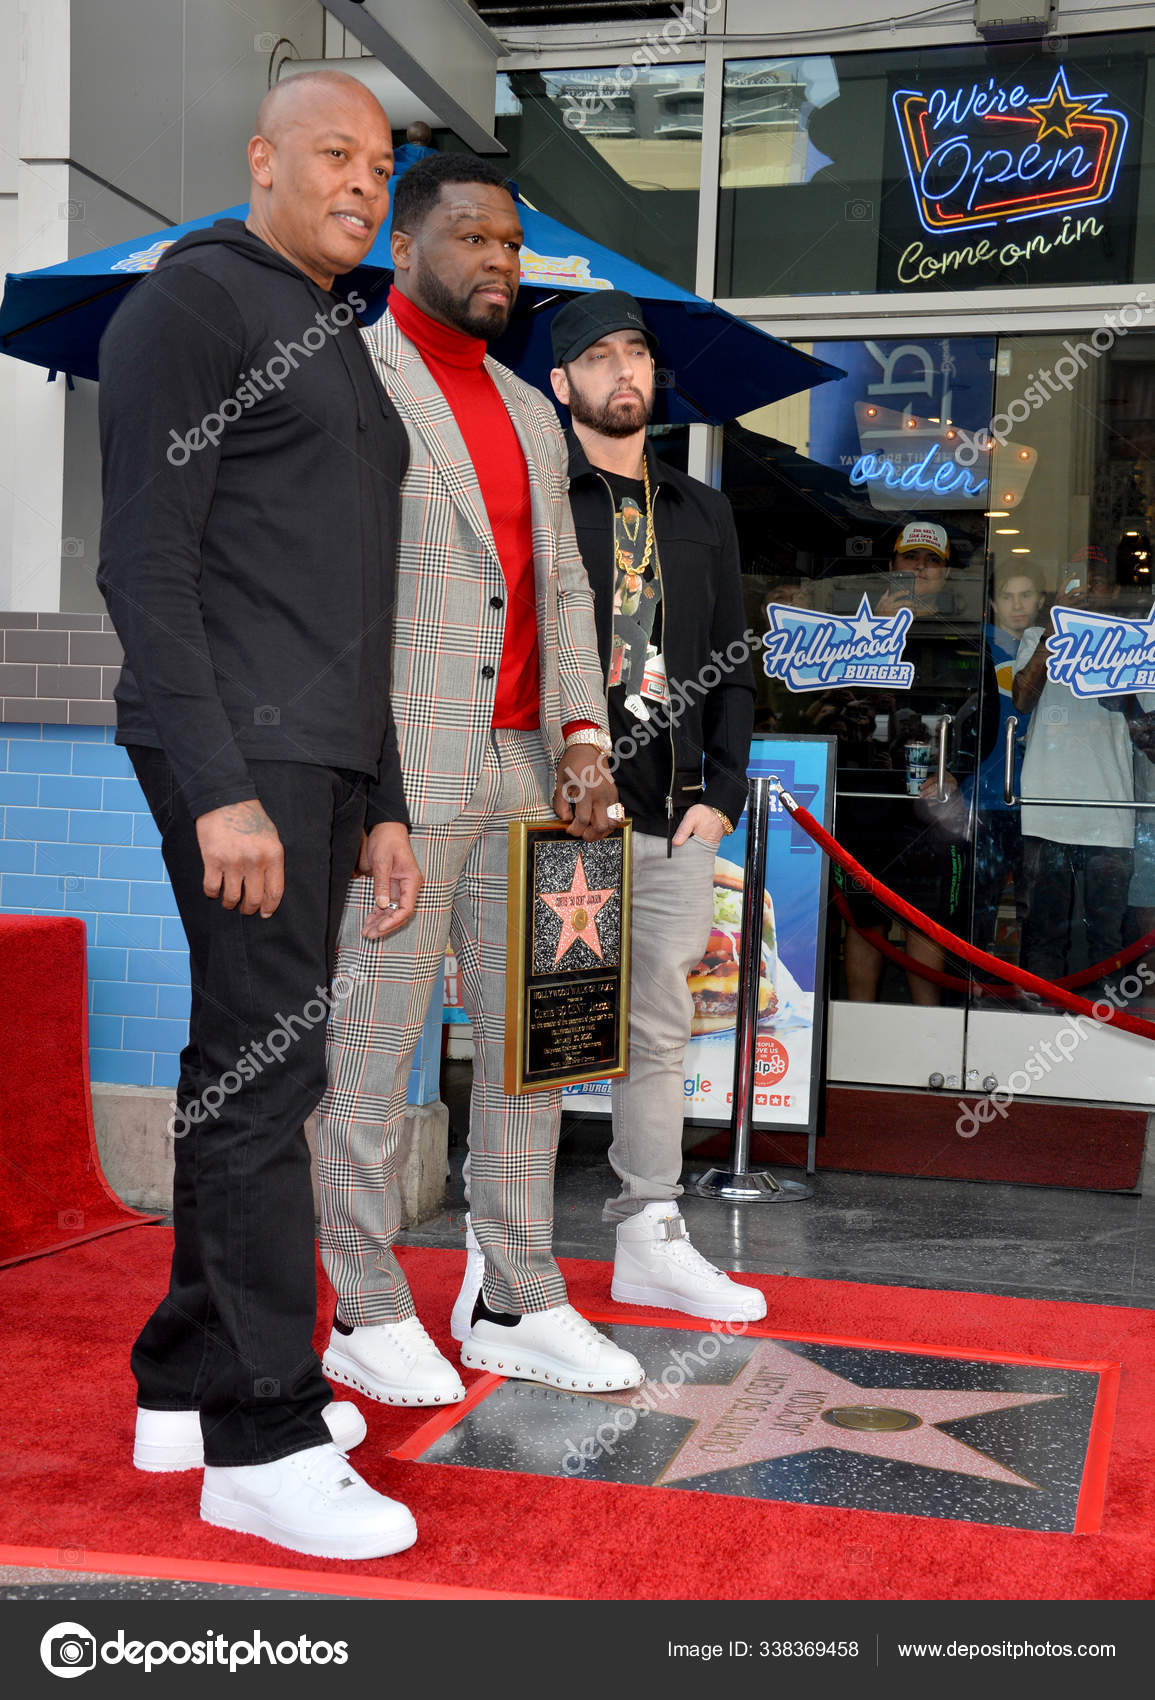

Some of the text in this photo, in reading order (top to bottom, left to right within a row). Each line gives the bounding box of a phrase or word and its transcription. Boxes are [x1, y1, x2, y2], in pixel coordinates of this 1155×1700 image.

[927, 77, 1029, 130] We're
[920, 135, 1092, 210] Open
[897, 215, 1104, 283] Come on in
[849, 442, 989, 496] order
[768, 614, 907, 679] Hollywood
[844, 664, 910, 681] BURGER
[1051, 628, 1155, 685] Hollywo
[683, 1073, 712, 1096] gle
[754, 1060, 771, 1075] elp
